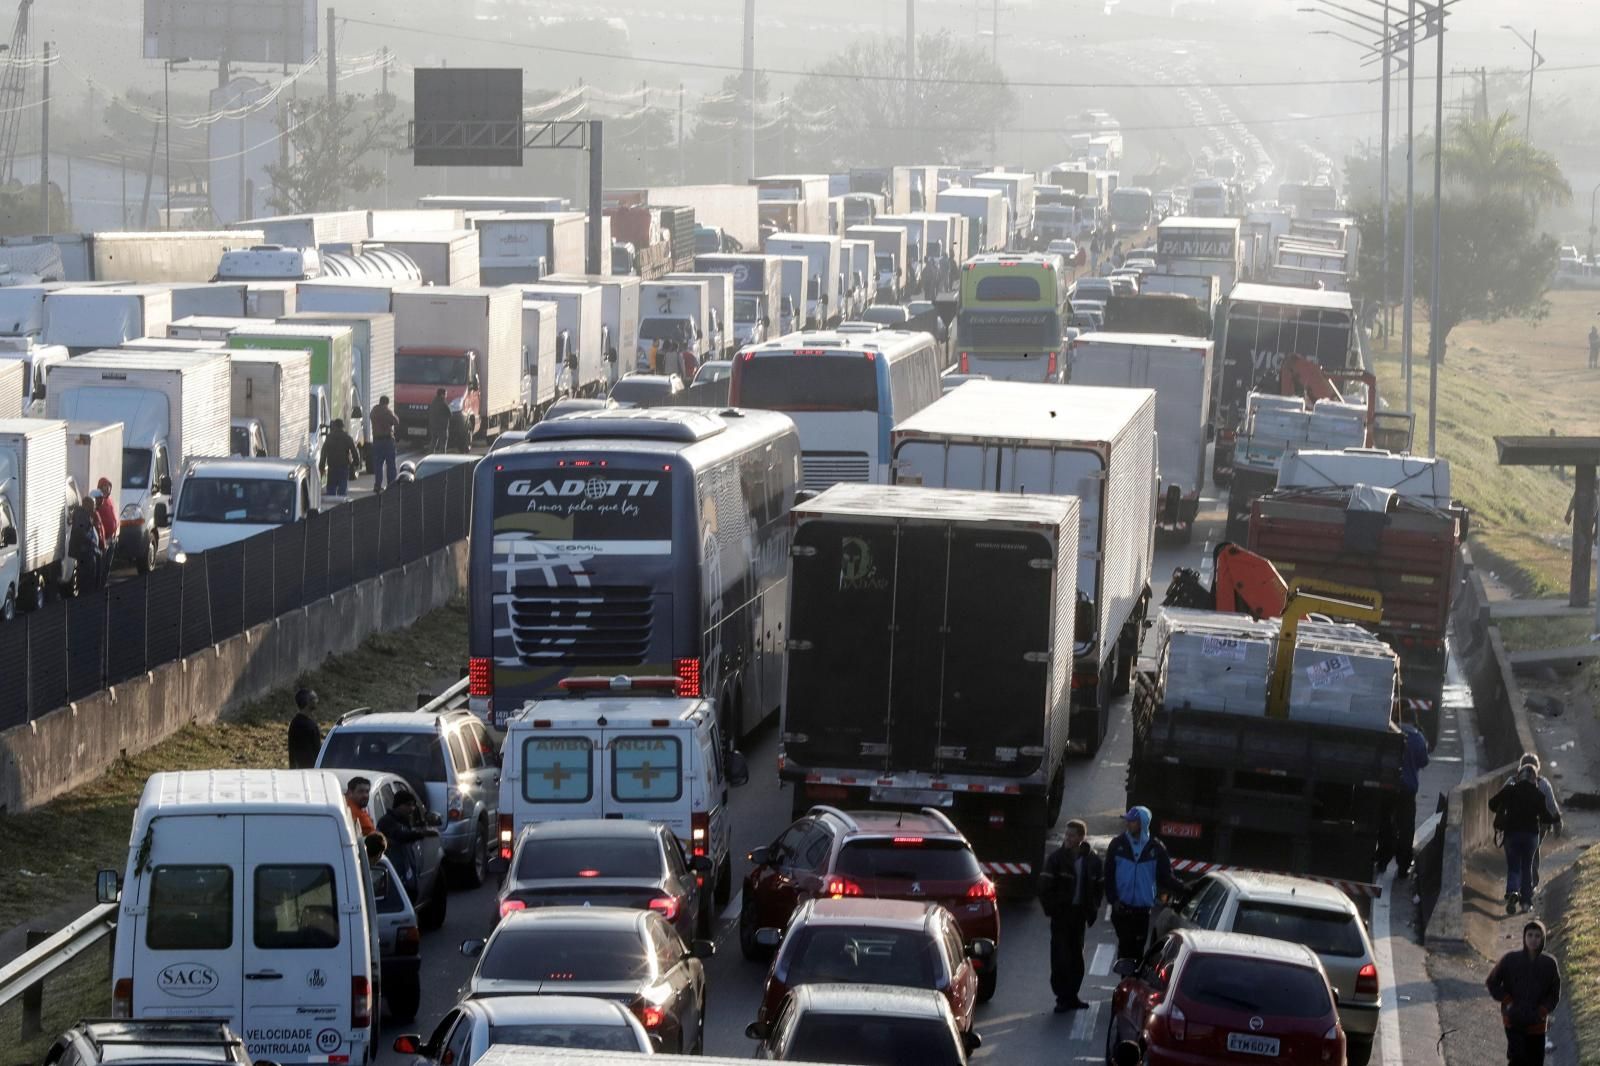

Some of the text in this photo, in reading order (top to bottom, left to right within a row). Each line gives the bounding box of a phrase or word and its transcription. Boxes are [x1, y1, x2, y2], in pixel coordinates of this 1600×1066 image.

[507, 478, 659, 499] GADOTTI
[527, 498, 640, 516] Amor pelo que faz
[1322, 658, 1341, 673] JB
[162, 968, 213, 985] SACS
[247, 1028, 313, 1040] VELOCIDADE
[321, 1033, 336, 1044] 80
[247, 1043, 311, 1055] CONTROLADA
